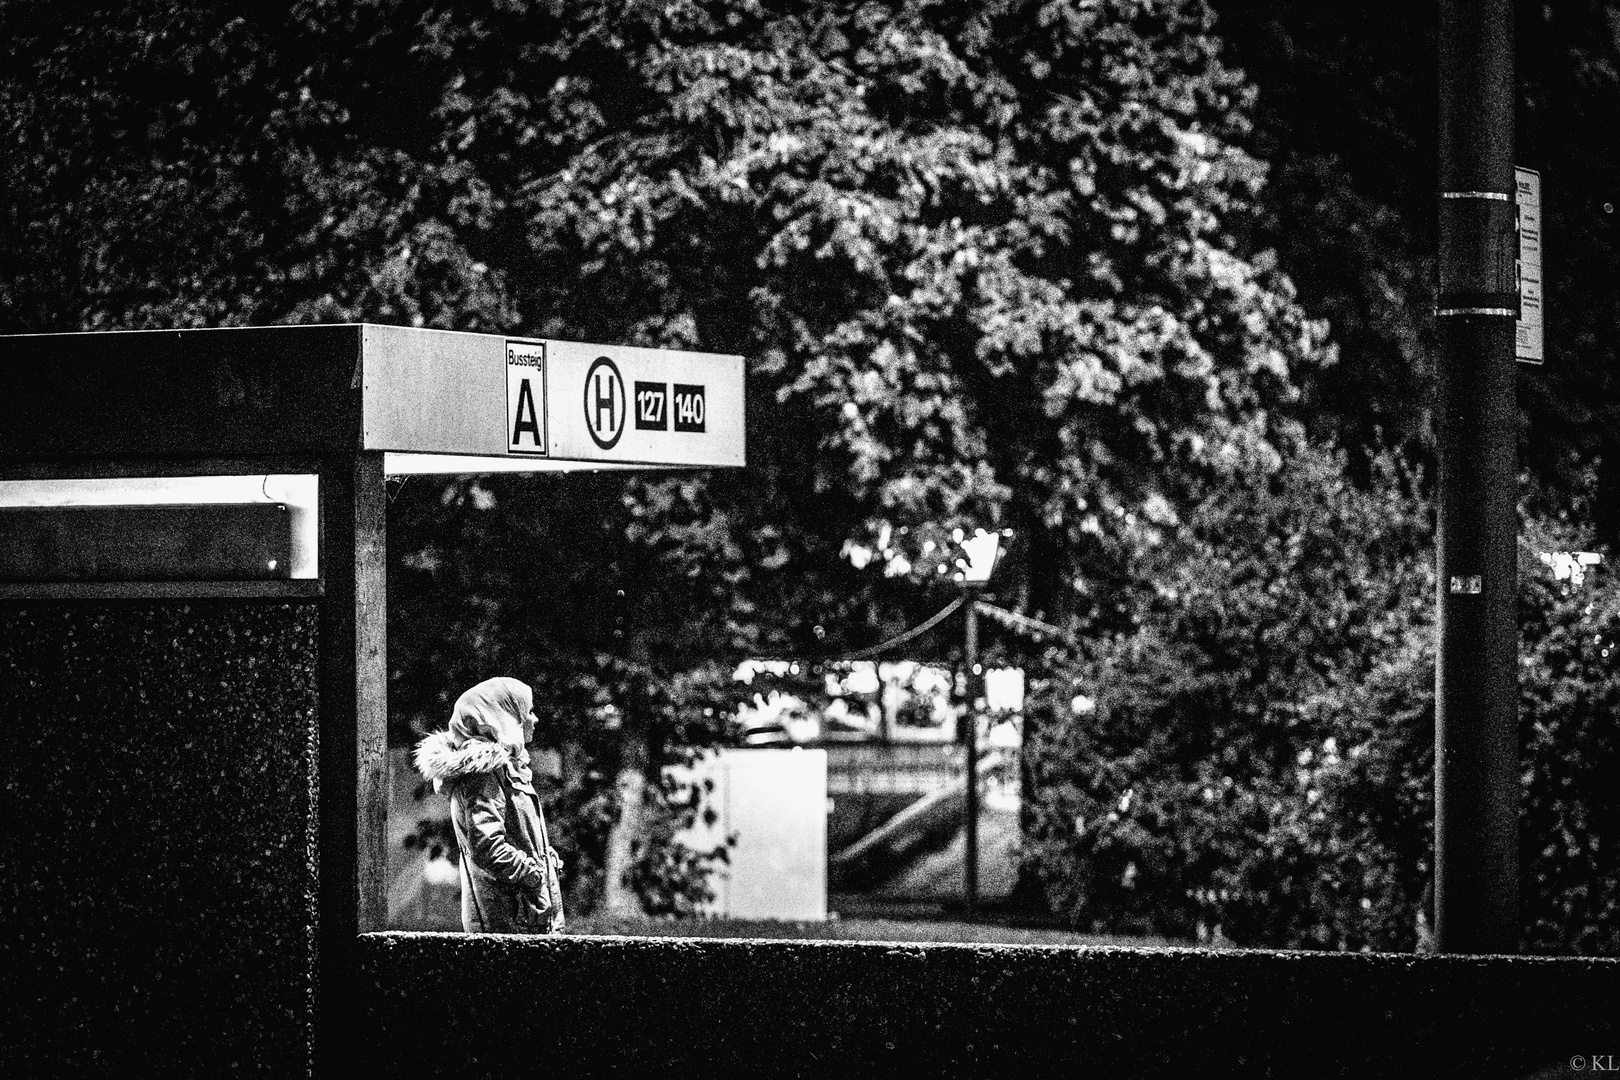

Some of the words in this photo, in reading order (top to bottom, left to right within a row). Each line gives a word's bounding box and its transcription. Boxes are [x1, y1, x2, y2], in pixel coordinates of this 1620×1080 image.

[508, 349, 542, 371] Bussteig
[512, 378, 542, 446] A
[595, 374, 615, 431] H
[637, 390, 665, 422] 127
[675, 393, 705, 424] 140
